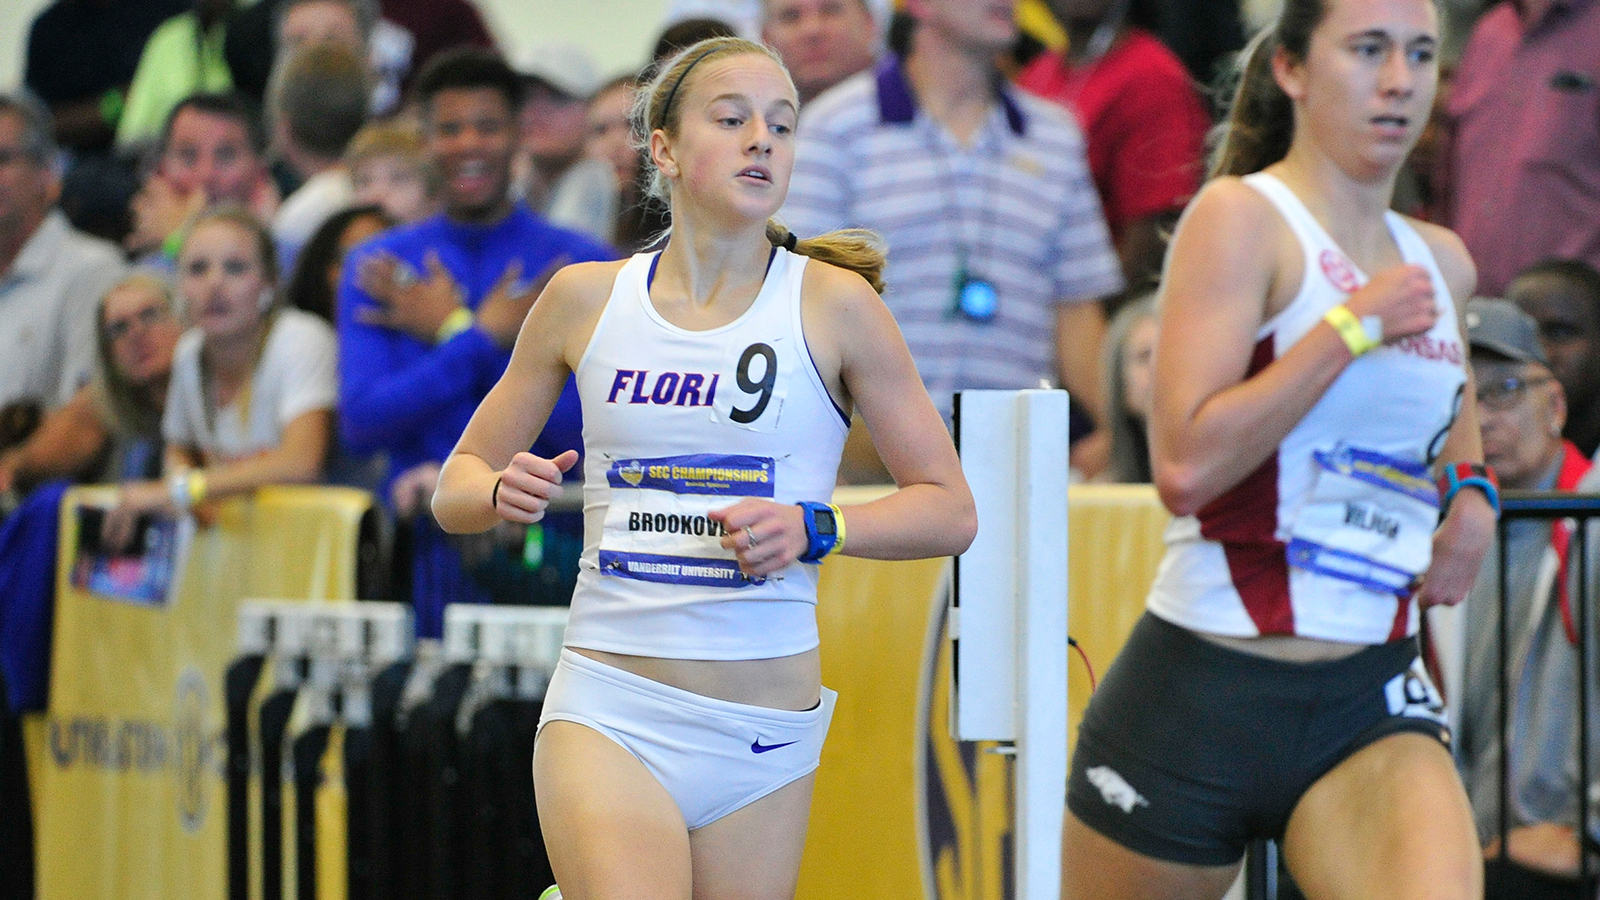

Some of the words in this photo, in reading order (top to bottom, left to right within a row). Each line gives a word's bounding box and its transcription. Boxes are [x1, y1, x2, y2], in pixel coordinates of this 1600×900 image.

[606, 369, 719, 407] FLORI
[729, 342, 778, 424] 9
[648, 465, 671, 479] SEC
[672, 466, 769, 484] CHAMPIONSHIPS
[628, 511, 728, 537] BROOKOV
[627, 560, 681, 576] VANDERBILT
[681, 565, 736, 580] UNIVERSITY
